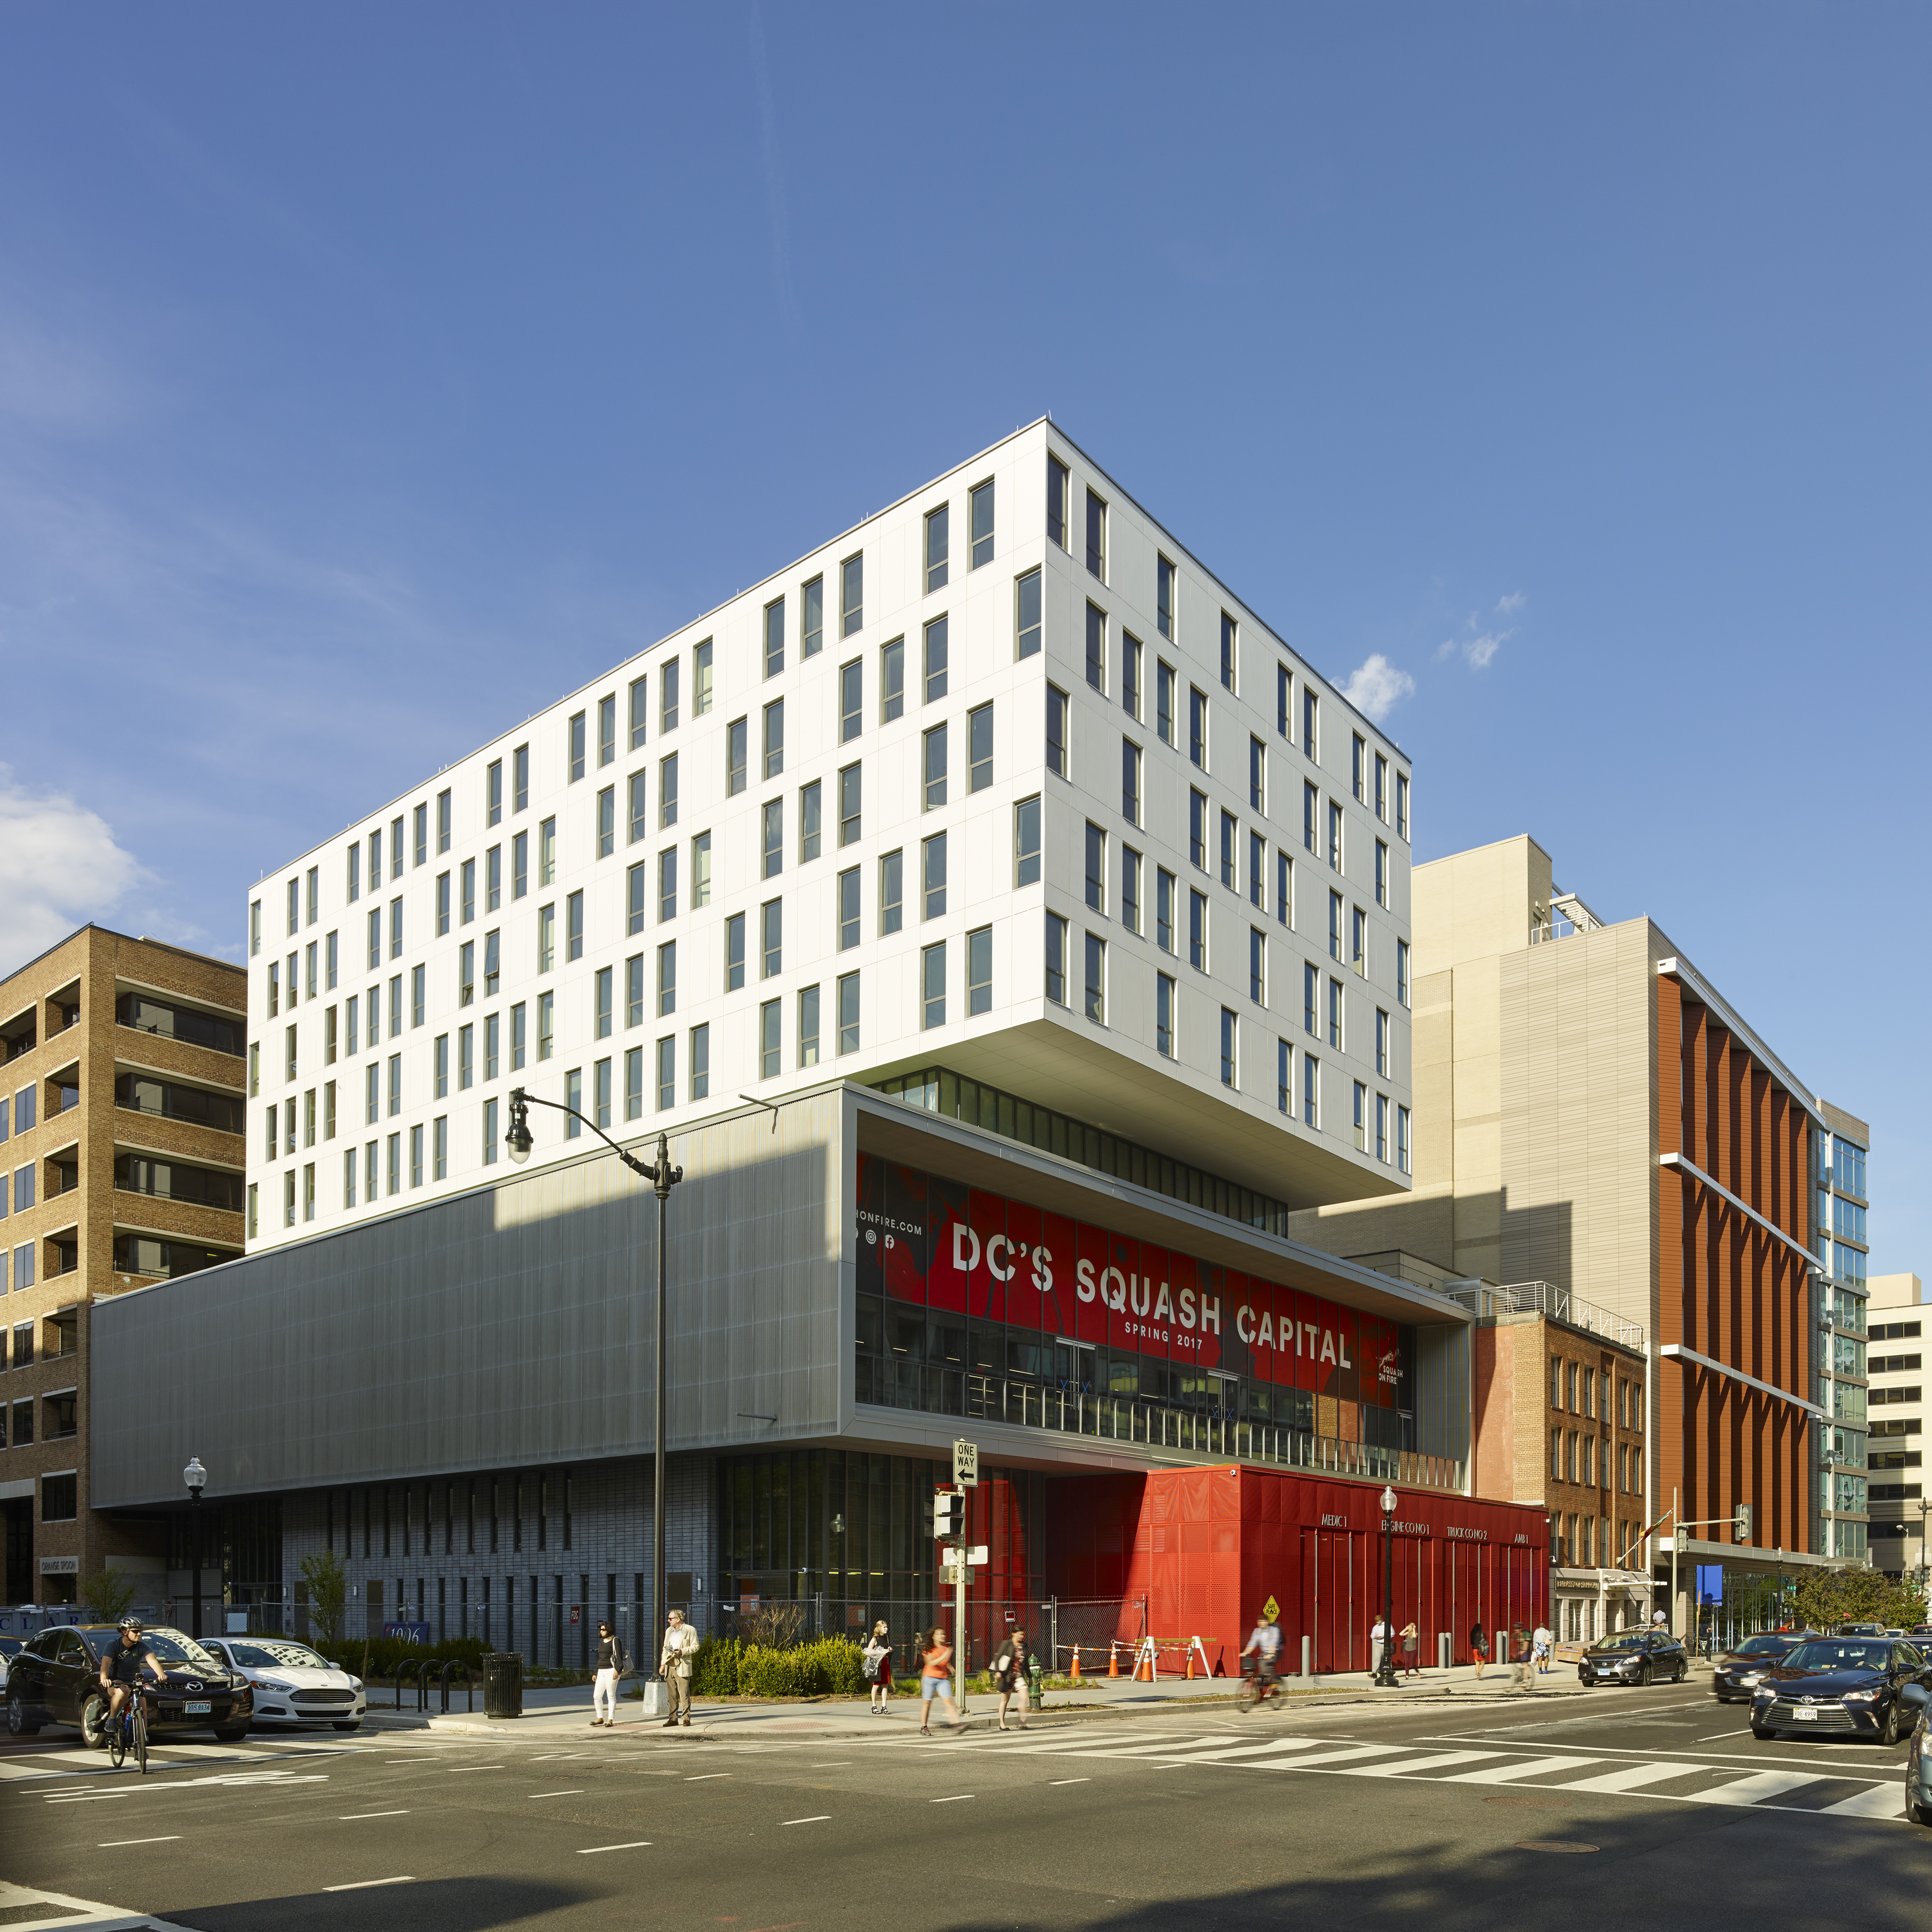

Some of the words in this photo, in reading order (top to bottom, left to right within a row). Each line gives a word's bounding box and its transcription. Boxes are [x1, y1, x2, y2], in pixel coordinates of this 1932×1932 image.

[1077, 1258, 1220, 1335] SQUASH
[1236, 1305, 1351, 1369] CAPITAL
[1125, 1322, 1168, 1342] SPRING
[1177, 1334, 1202, 1350] 2017
[1383, 1365, 1403, 1378] SQUASH
[1379, 1373, 1386, 1382] ON
[1386, 1374, 1397, 1385] FIRE
[958, 1445, 974, 1456] ONE
[957, 1456, 975, 1467] WAY
[1321, 1513, 1343, 1527] MEDIC
[1344, 1516, 1347, 1527] 1
[1405, 1522, 1415, 1533] CO
[1415, 1523, 1426, 1535] NO
[1426, 1525, 1430, 1535] 1
[1447, 1526, 1465, 1538] TRUCK
[1465, 1528, 1473, 1539] CO
[1474, 1529, 1483, 1540] NO
[1483, 1530, 1488, 1540] 2
[1514, 1533, 1526, 1544] AMB
[1526, 1535, 1528, 1545] 1
[42, 1561, 59, 1571] ORANGE
[61, 1560, 76, 1570] SPOON
[571, 1611, 579, 1620] FDC
